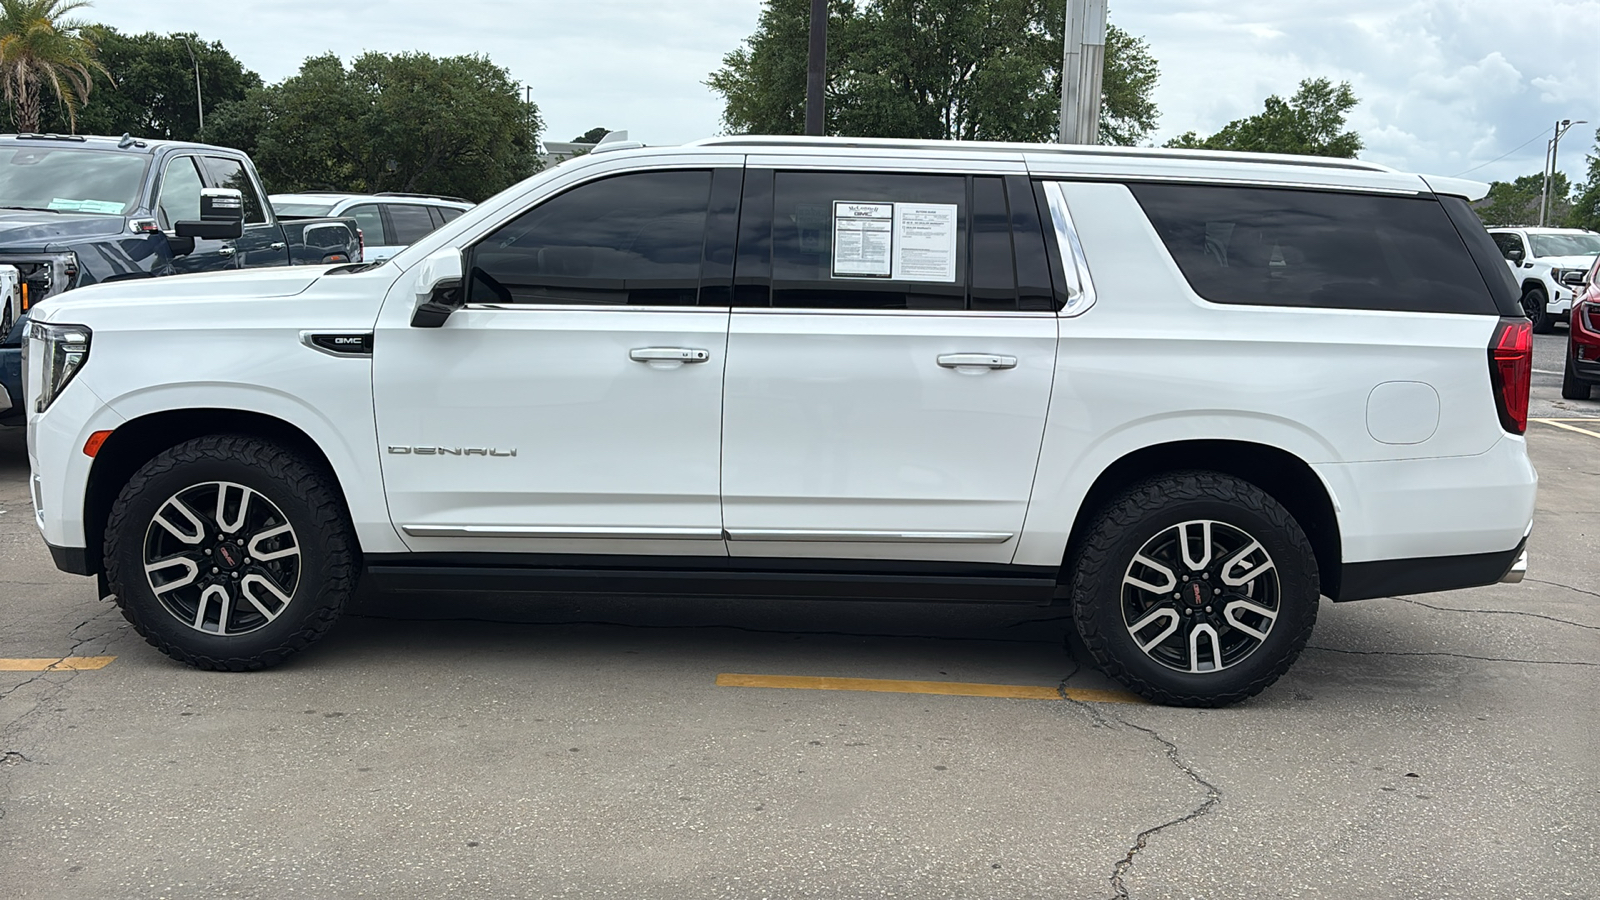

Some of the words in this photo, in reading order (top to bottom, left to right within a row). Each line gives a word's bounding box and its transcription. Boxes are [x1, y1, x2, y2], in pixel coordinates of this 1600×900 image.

[387, 445, 518, 457] DENALI
[220, 547, 235, 566] GMC
[1193, 583, 1202, 604] GMC
